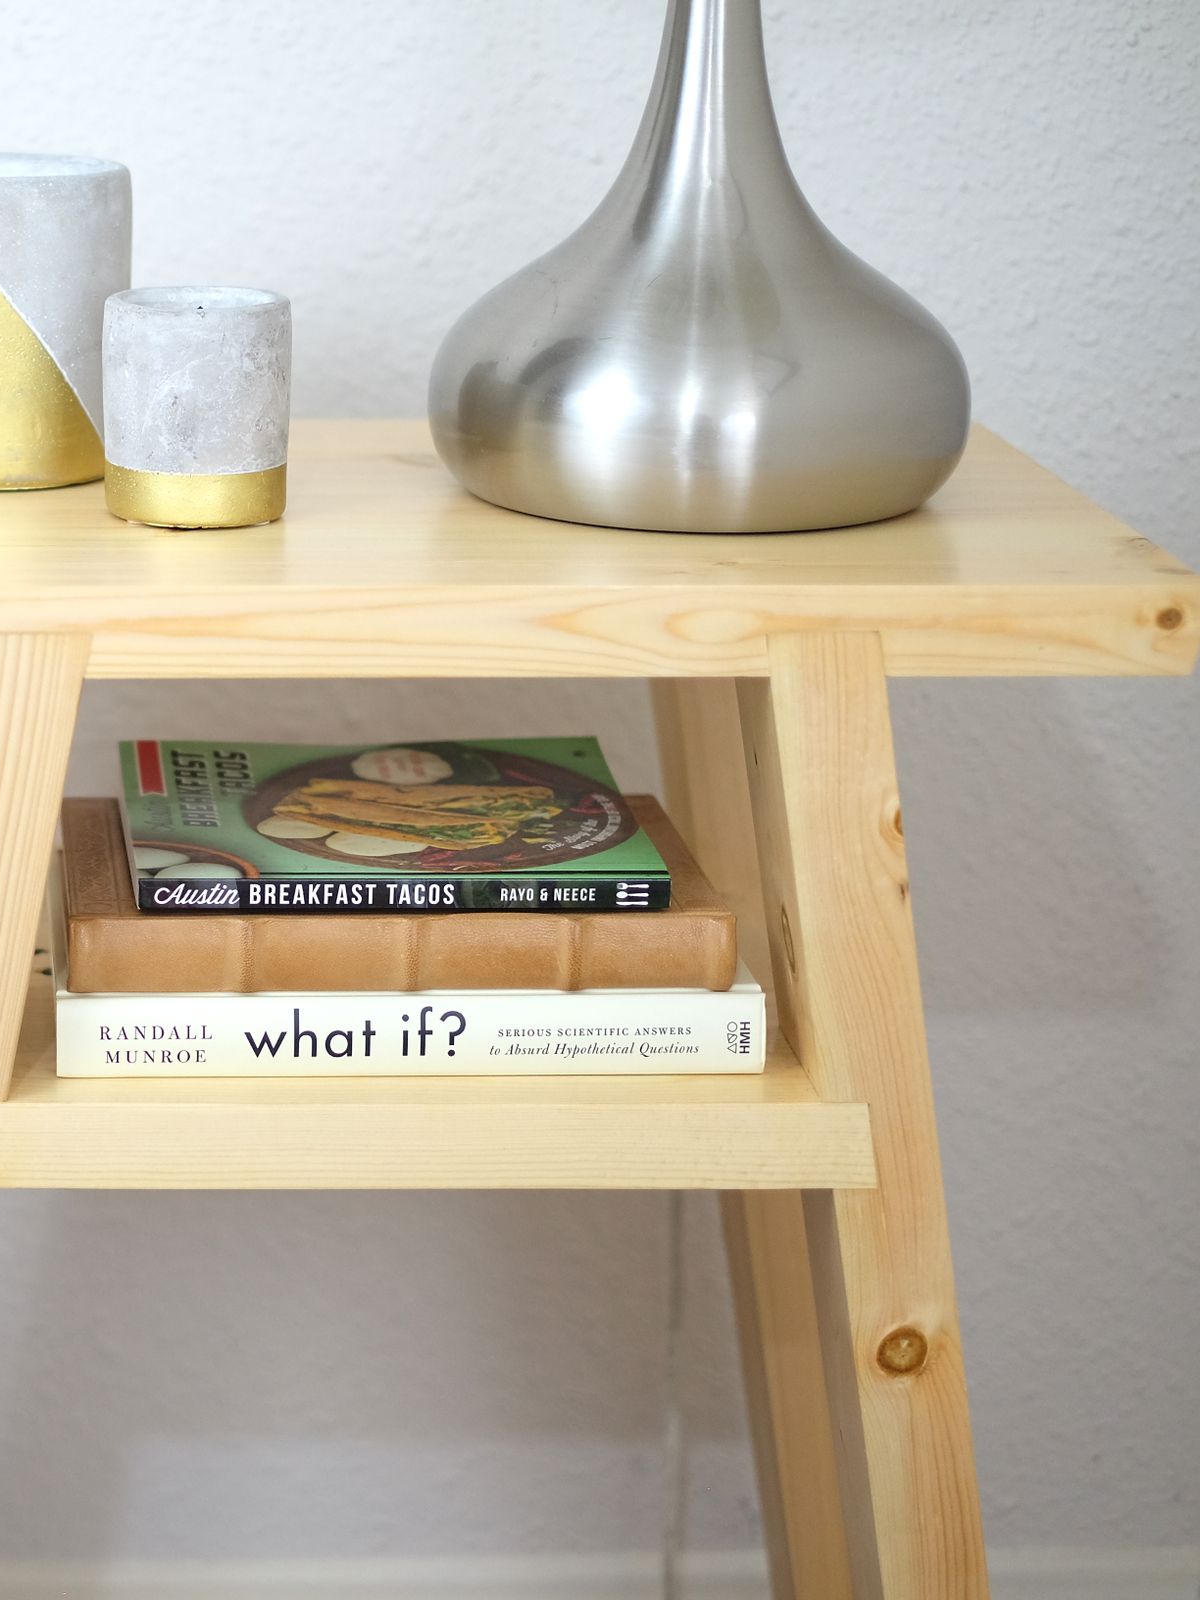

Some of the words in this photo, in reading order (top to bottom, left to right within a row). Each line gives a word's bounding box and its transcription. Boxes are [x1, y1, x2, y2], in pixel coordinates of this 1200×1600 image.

[213, 750, 257, 795] TACOS
[171, 749, 220, 828] BREAKFAST
[153, 882, 241, 905] Austin
[249, 883, 377, 905] BREAKFAST
[385, 883, 455, 905] TACOS
[500, 887, 534, 902] RAYO
[539, 887, 549, 902] &
[553, 887, 596, 902] NEECE
[99, 1024, 213, 1041] RANDALL
[244, 1008, 376, 1058] what
[401, 1006, 467, 1057] if?
[497, 1027, 552, 1037] SERIOUS
[557, 1027, 629, 1037] SCIENTIFIC
[634, 1026, 692, 1036] ANSWERS
[738, 1021, 751, 1054] HMH
[105, 1049, 207, 1064] MUNROE
[489, 1045, 501, 1056] to
[504, 1042, 549, 1056] Absurd
[553, 1041, 634, 1059] Hypothetical
[639, 1041, 699, 1058] Questions
